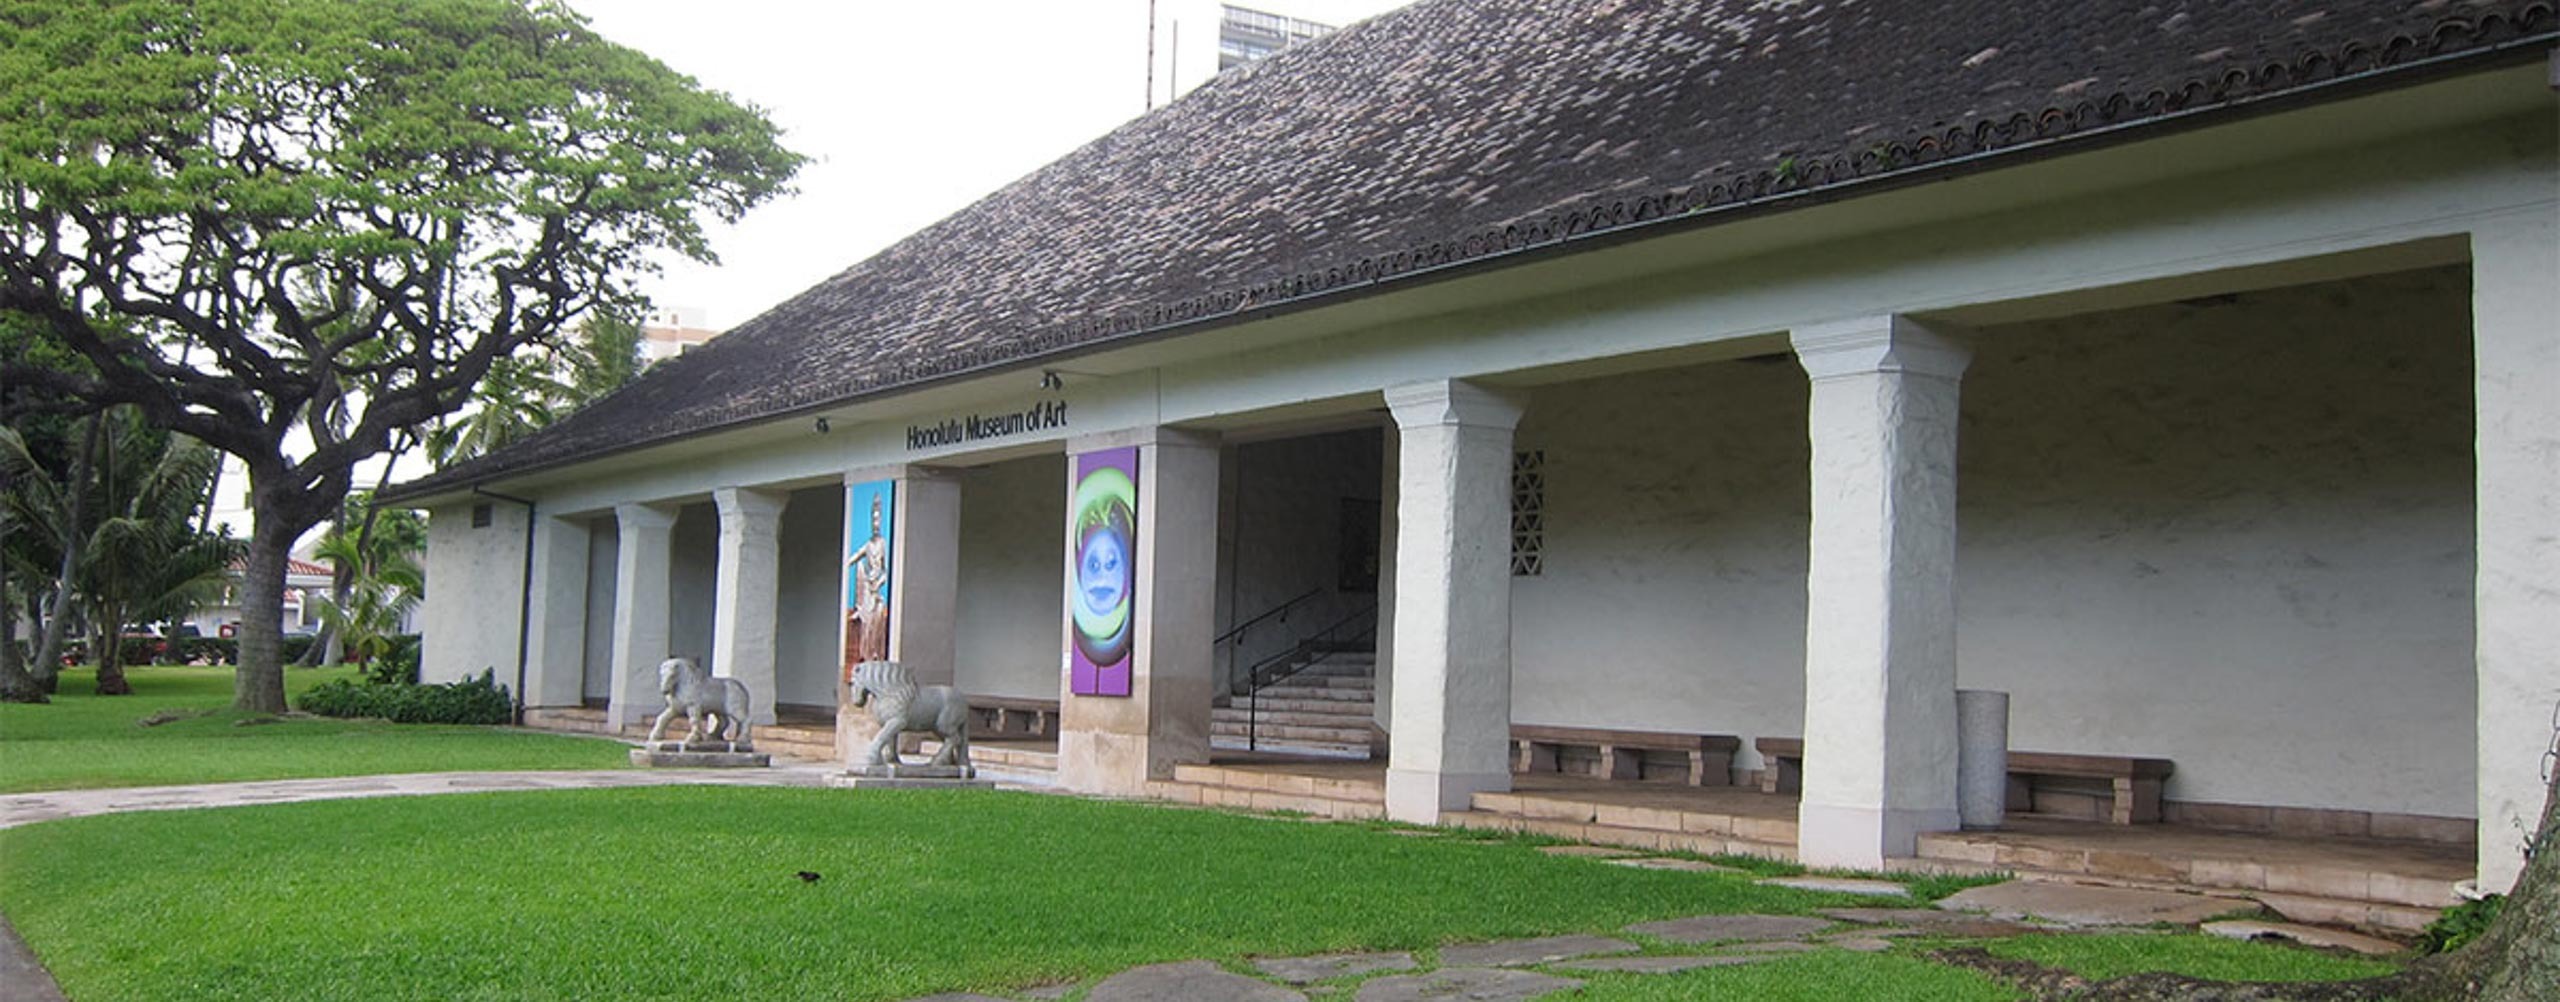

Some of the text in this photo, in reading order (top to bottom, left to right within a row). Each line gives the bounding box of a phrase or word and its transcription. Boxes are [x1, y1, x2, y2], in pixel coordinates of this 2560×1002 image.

[907, 400, 1067, 450] Honolulu Museum of Art
